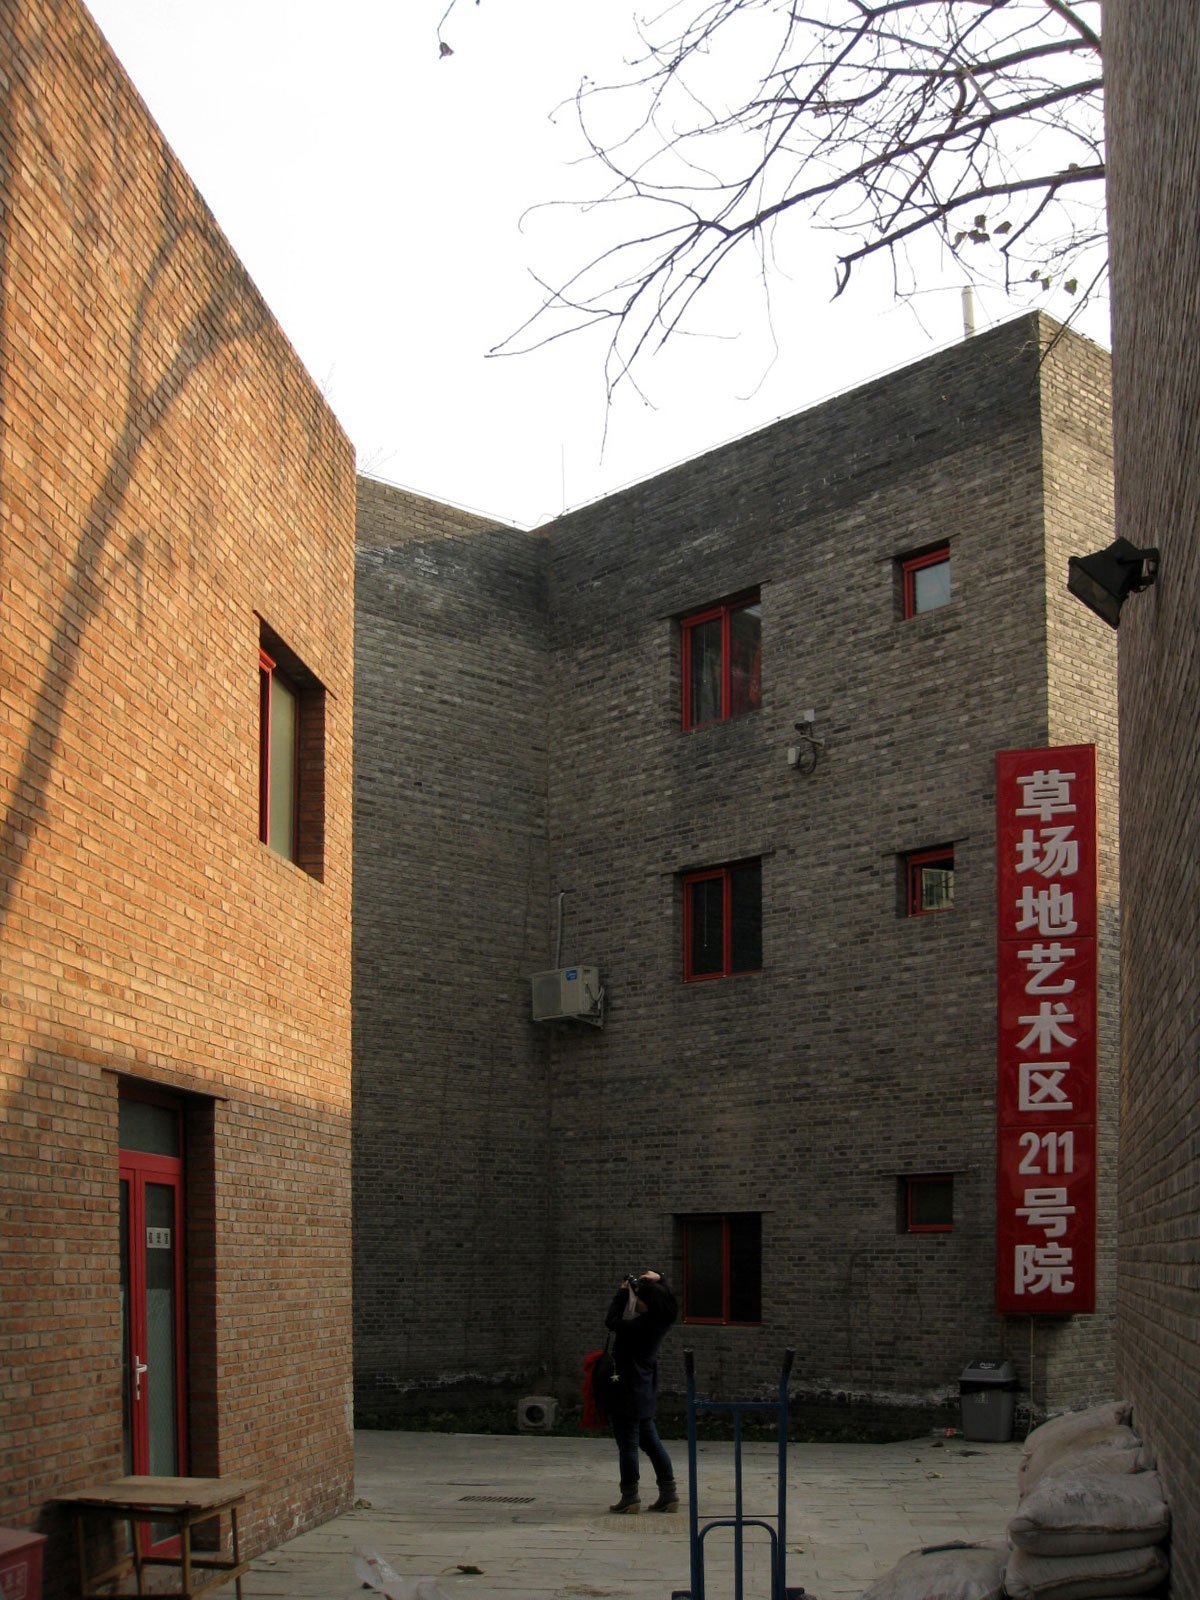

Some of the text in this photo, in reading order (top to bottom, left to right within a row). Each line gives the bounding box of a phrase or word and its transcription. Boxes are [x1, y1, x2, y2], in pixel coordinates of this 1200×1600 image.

[1014, 769, 1079, 1294] 草场地艺术区211号院
